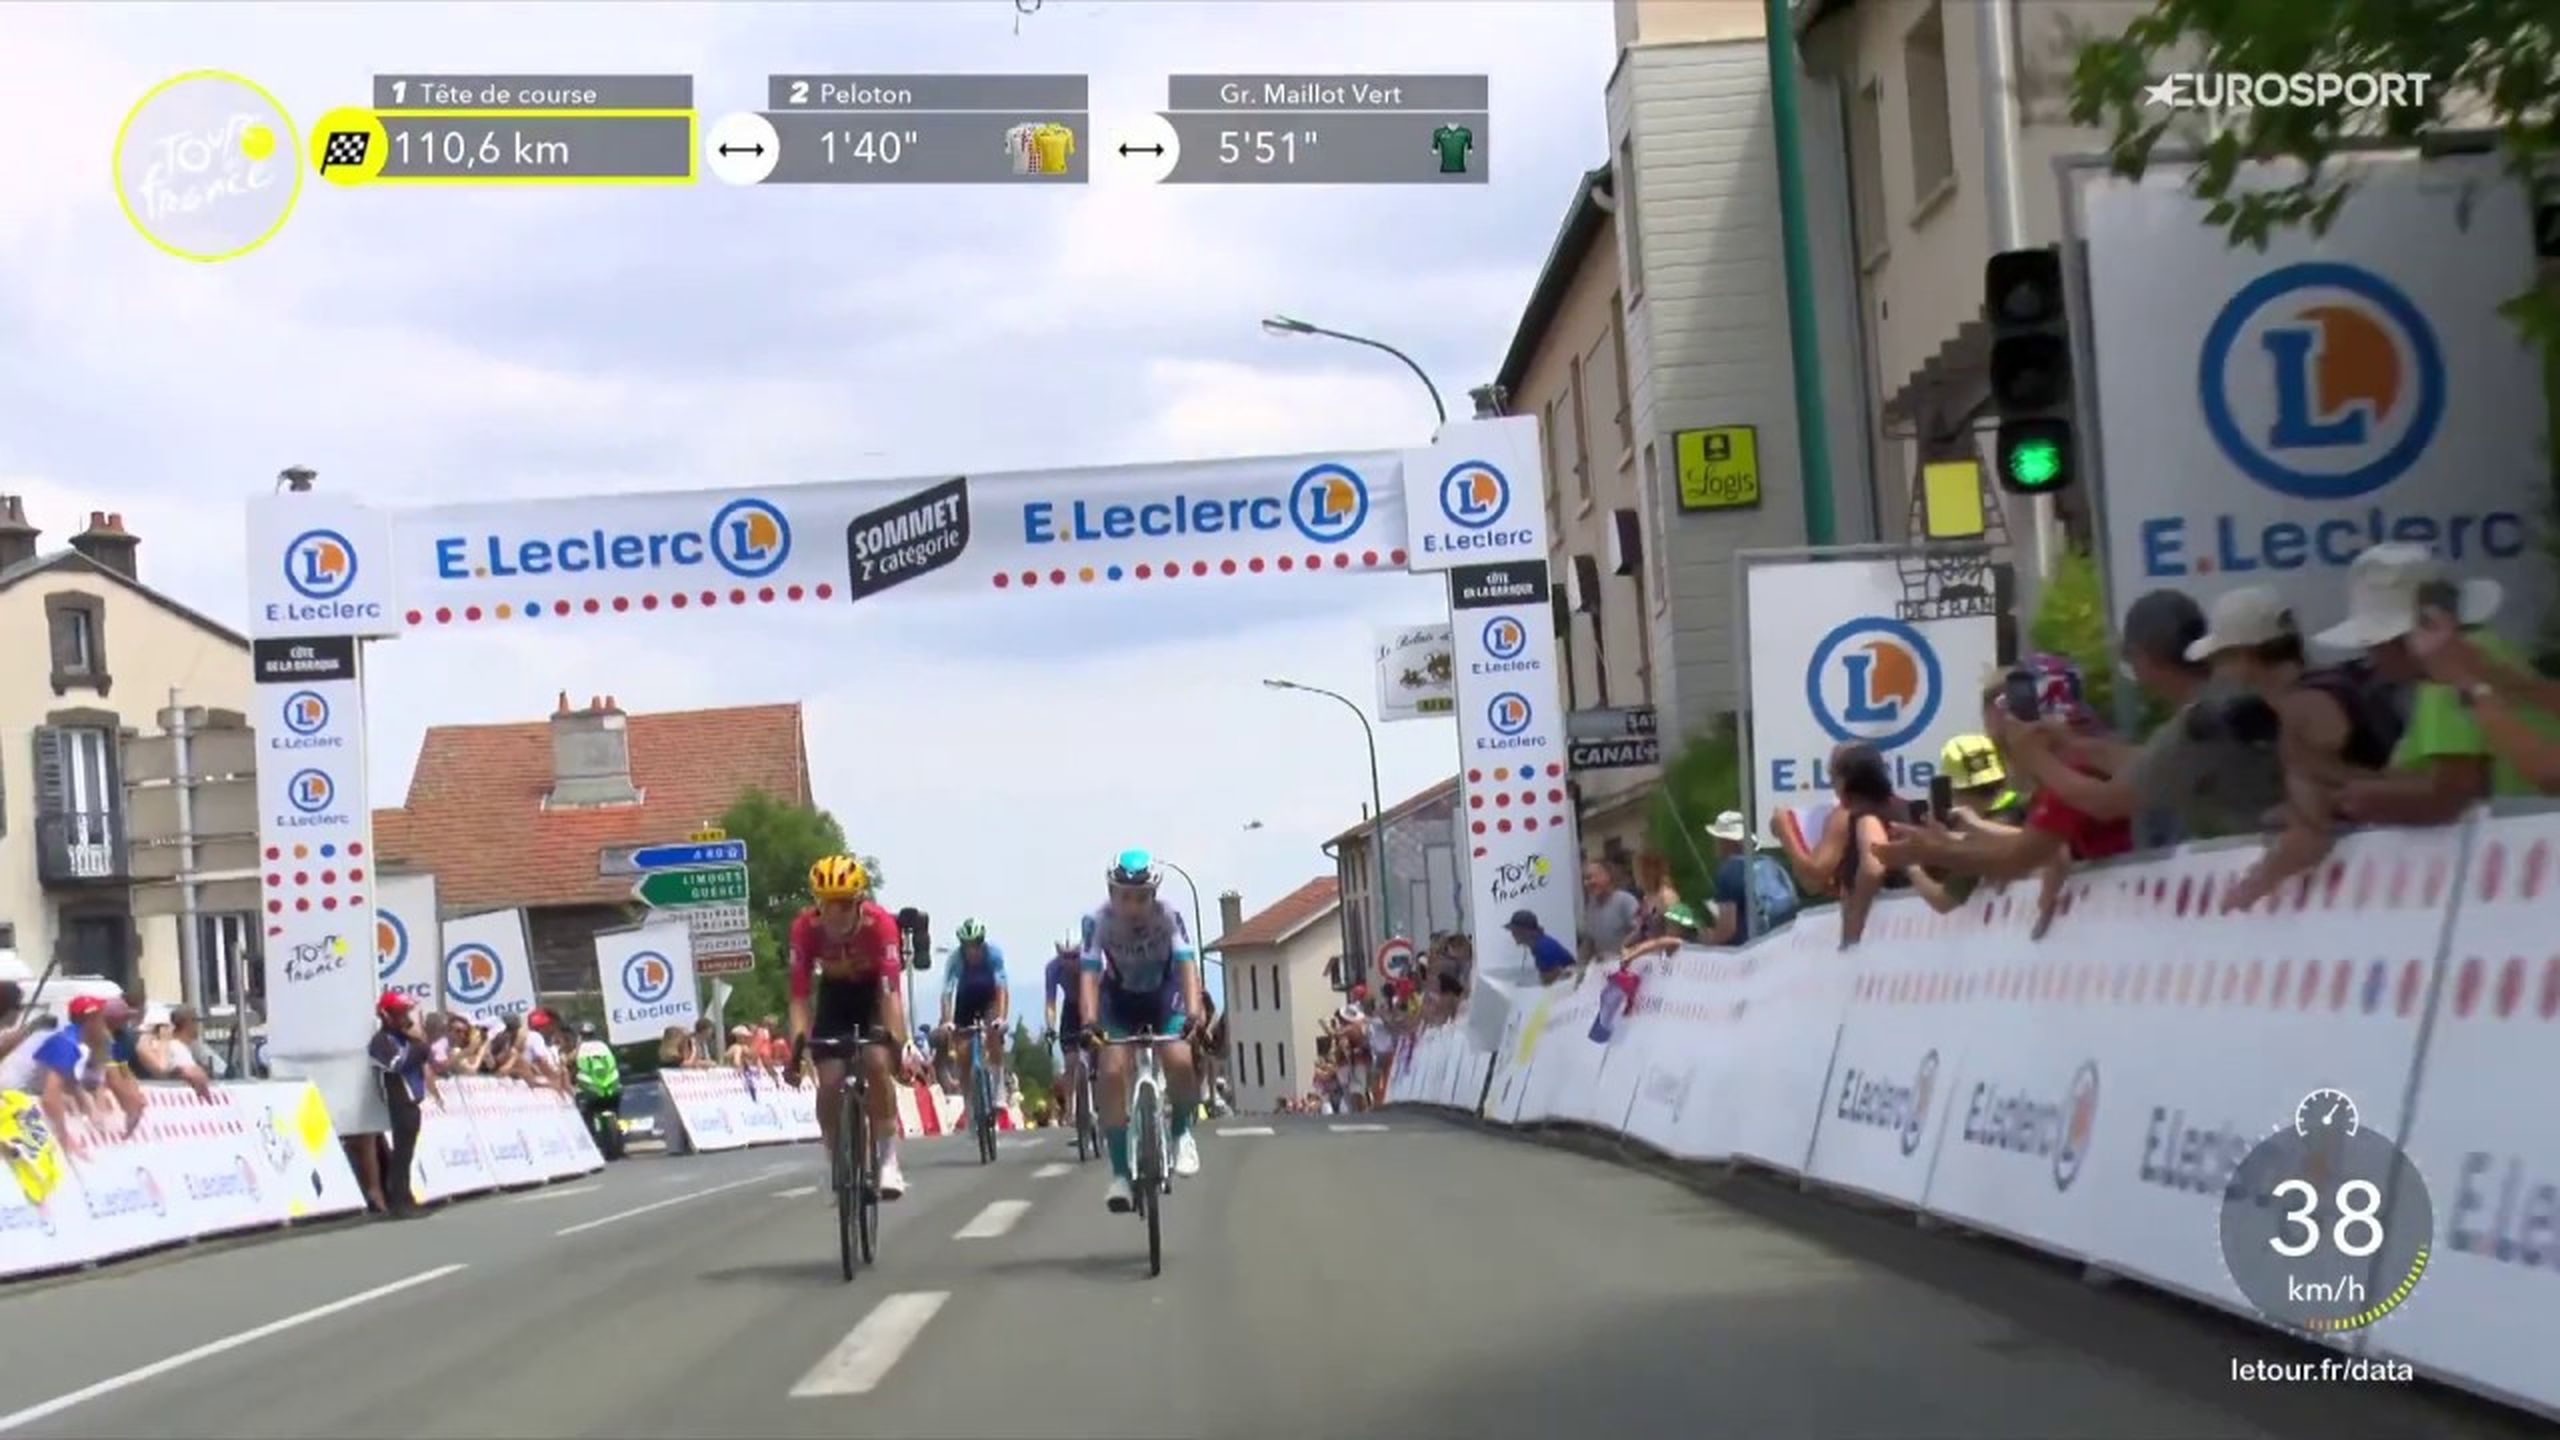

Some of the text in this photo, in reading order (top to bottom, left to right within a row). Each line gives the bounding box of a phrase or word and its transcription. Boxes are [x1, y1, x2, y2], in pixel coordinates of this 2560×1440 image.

[855, 493, 960, 560] SOMMET
[1023, 496, 1283, 544] E.Leclerc
[1423, 526, 1533, 554] E.Leclerc
[2142, 506, 2526, 577] E.Leclerc
[436, 529, 704, 580] E.Leclerc
[265, 600, 381, 623] E.Leclerc
[612, 1002, 692, 1023] E.Leclerc
